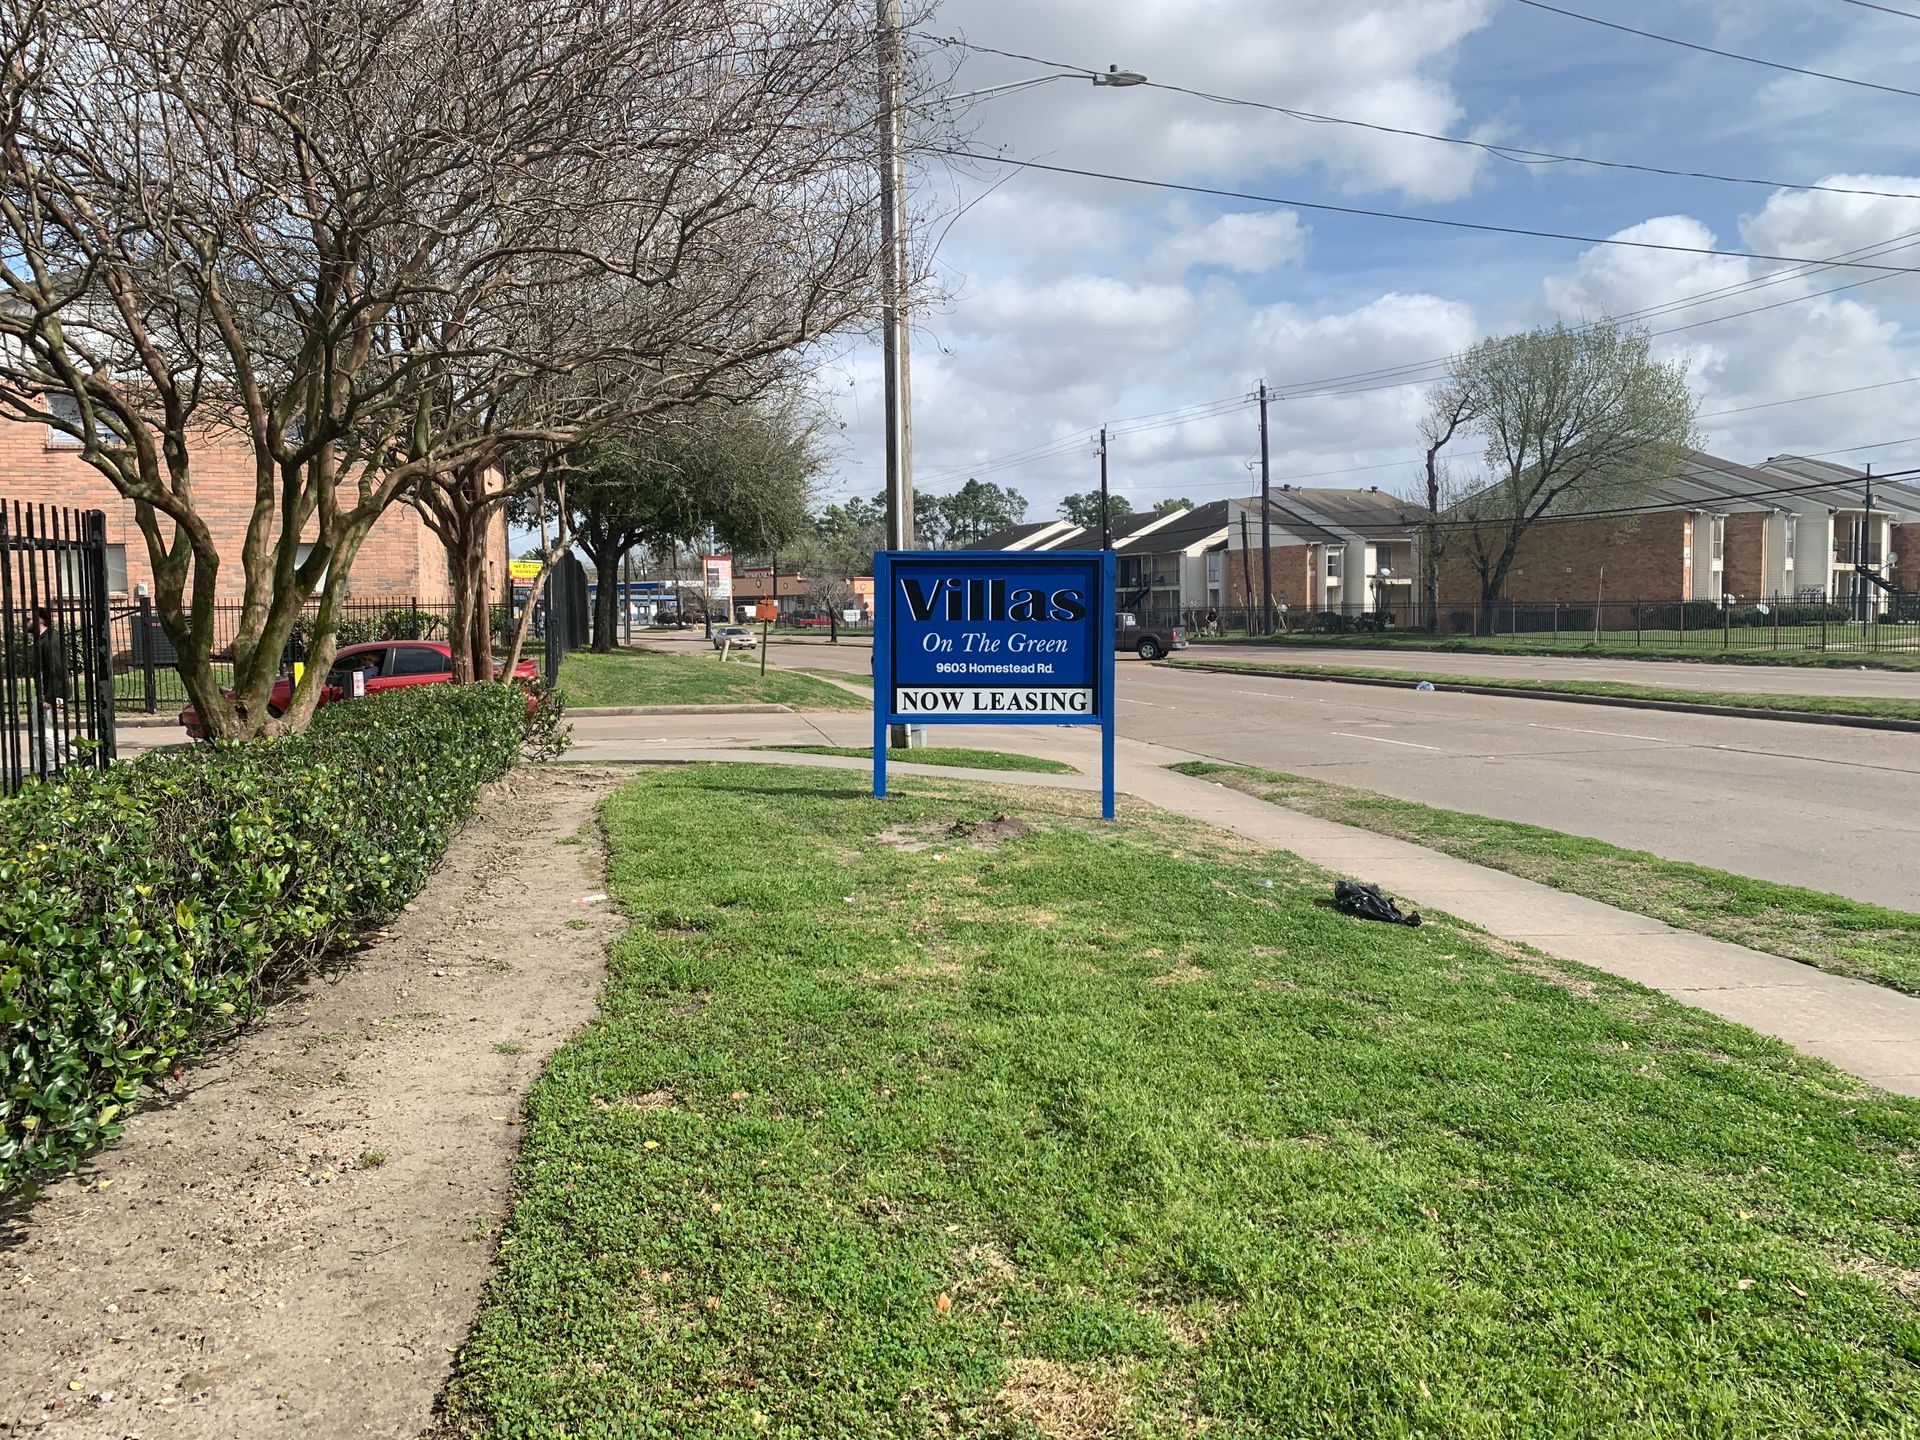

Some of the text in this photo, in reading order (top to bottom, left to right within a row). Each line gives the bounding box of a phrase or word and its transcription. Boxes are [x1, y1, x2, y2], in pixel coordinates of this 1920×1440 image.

[900, 578, 1086, 622] Villas
[922, 632, 1068, 653] On The Green
[936, 662, 1055, 674] 9603 Homestead Rd.
[902, 692, 1088, 711] NOW LEASING
